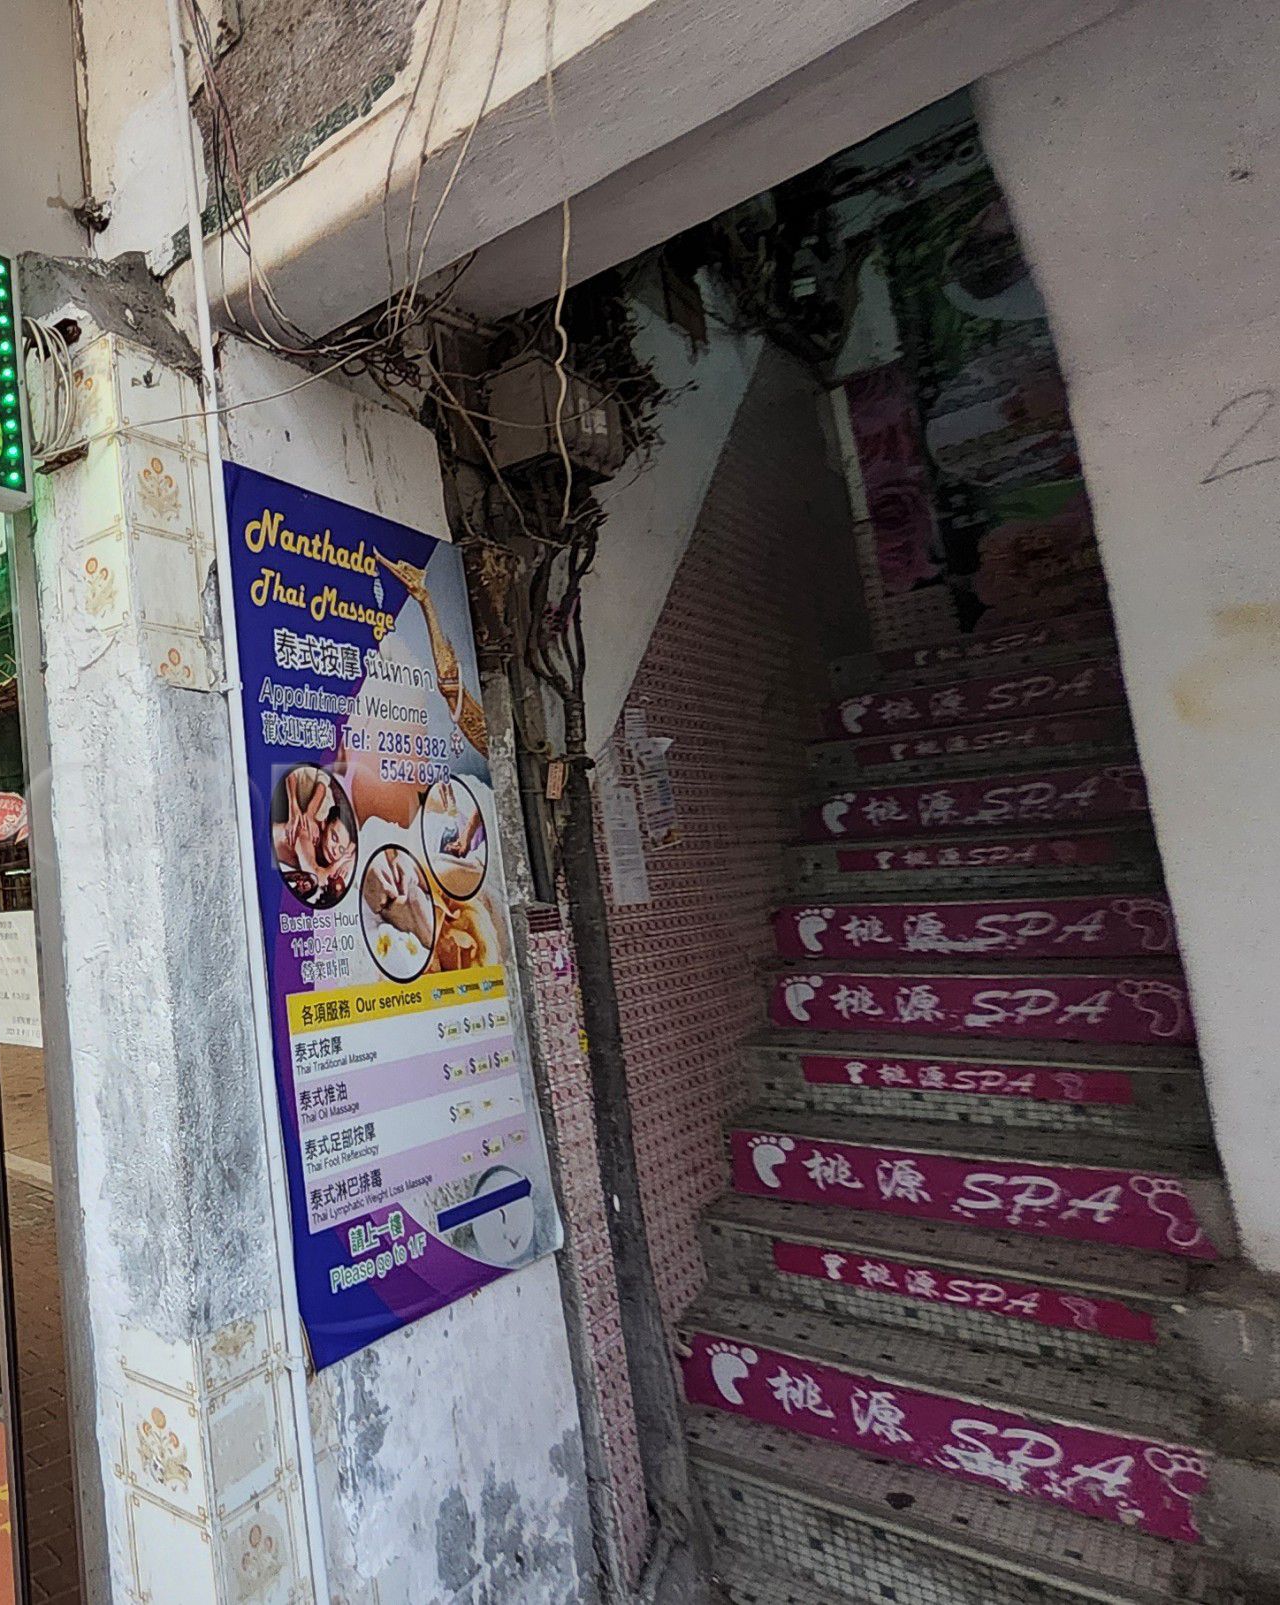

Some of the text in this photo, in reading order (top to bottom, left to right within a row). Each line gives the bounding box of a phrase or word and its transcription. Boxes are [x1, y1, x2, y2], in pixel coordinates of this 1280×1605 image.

[245, 509, 379, 577] Nanthada
[250, 567, 396, 641] Thai Massage
[274, 629, 362, 680] 泰式按摩
[259, 677, 429, 726] Appointment Welcome
[342, 726, 370, 750] Tel:
[378, 731, 412, 755] 2385
[415, 736, 448, 759] 9382
[380, 759, 451, 784] 5542 8978
[280, 912, 332, 934] Business
[839, 908, 1111, 951] 桃源 SPA
[290, 934, 356, 959] 11:00-24:00
[301, 990, 423, 1027] 各項服務 Our services
[829, 984, 1118, 1028] 桃源 SPA
[294, 1035, 344, 1064] 泰式按摩
[296, 1050, 378, 1077] Thai Traditional Massage
[299, 1081, 348, 1111] 泰式推油
[950, 1069, 1039, 1094] SPA
[301, 1112, 317, 1125] Thai
[330, 1101, 360, 1118] Massage
[304, 1121, 377, 1160] 泰式足部按摩
[306, 1143, 380, 1175] Thai Foot Reflexology
[312, 1211, 329, 1225] Thai
[389, 1183, 405, 1198] Loss
[405, 1173, 433, 1192] Massage
[801, 1149, 1124, 1223] 桃源 SPA
[349, 1212, 403, 1256] 請上一樓
[330, 1264, 375, 1293] Please
[375, 1254, 393, 1279] go
[393, 1243, 407, 1266] to
[858, 1260, 1042, 1314] 桃源 SPA
[765, 1365, 1135, 1498] 桃源 SPA
